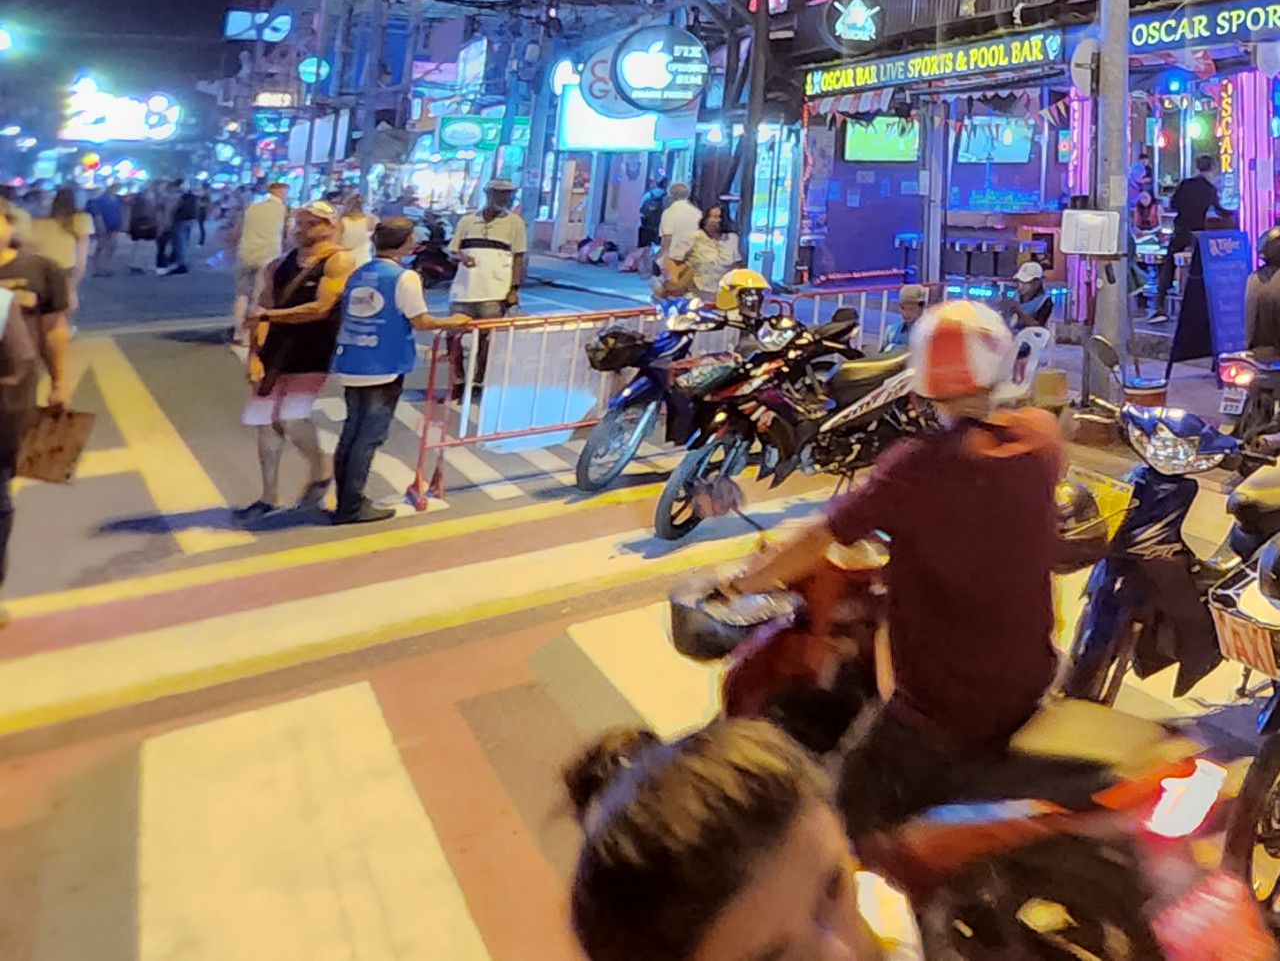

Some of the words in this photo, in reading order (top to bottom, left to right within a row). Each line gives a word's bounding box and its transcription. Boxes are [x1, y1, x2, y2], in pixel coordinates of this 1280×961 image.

[1131, 13, 1211, 47] OSCAR
[821, 67, 854, 91] OSCAR
[855, 64, 878, 86] BAR
[879, 61, 905, 83] LIVE
[907, 51, 954, 79] SPORTS
[956, 49, 969, 72] &
[969, 42, 1008, 70] POOL
[1011, 33, 1045, 65] BAR
